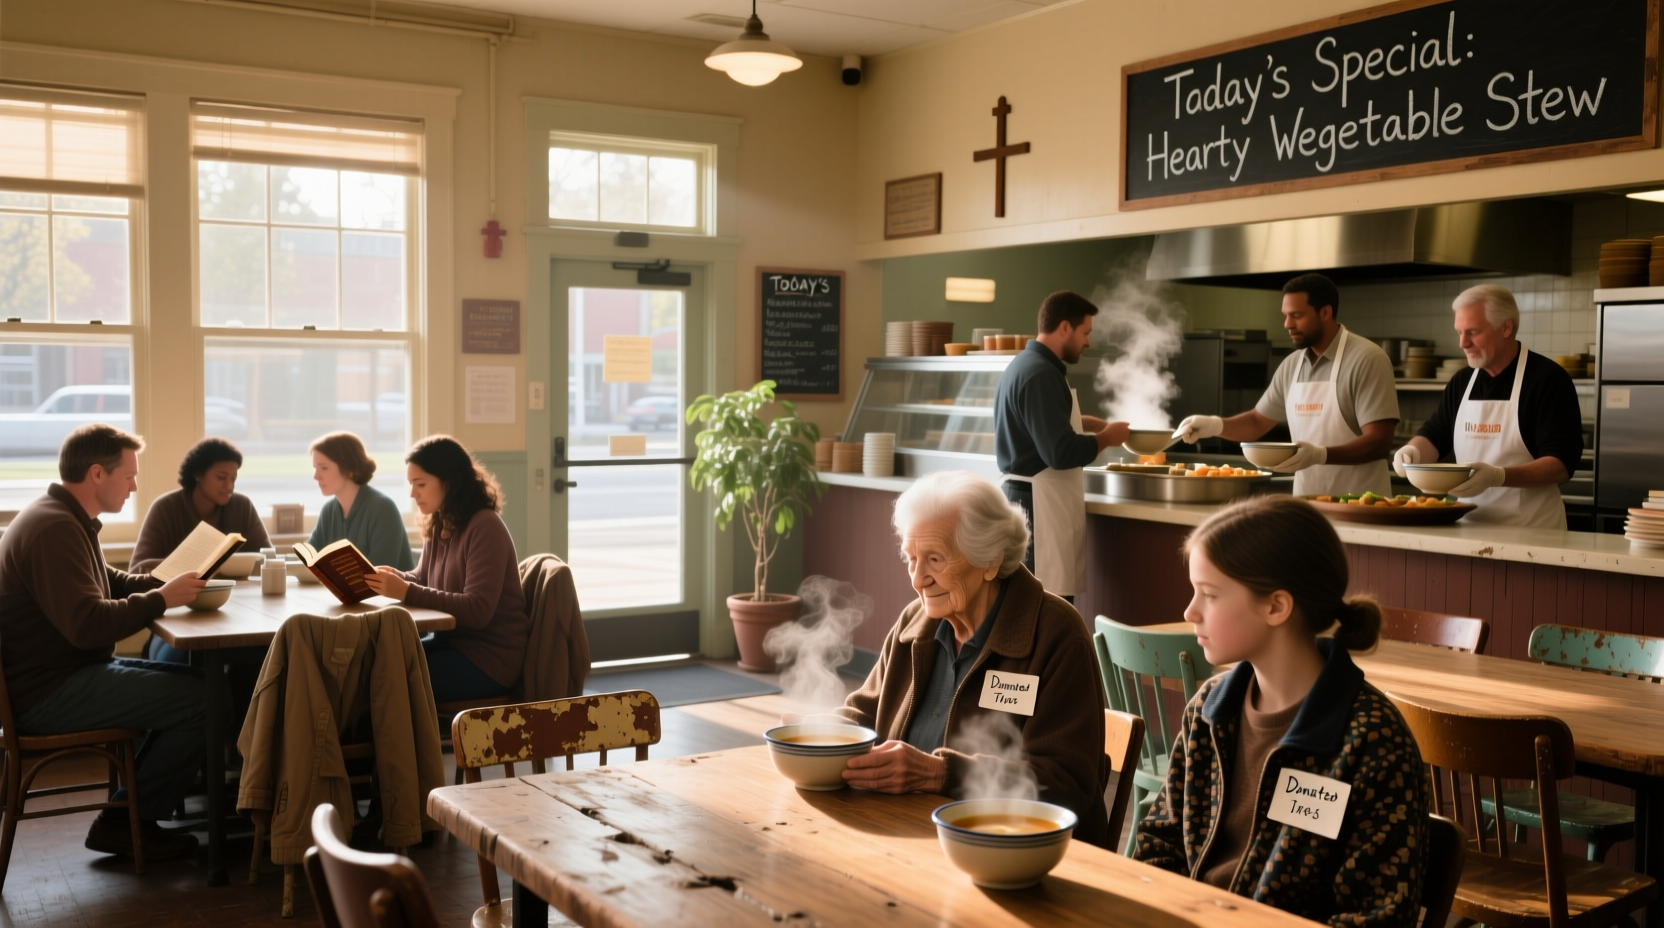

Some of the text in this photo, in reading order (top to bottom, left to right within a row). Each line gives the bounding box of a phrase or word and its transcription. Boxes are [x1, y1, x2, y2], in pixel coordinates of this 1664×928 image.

[1311, 10, 1474, 108] Special:
[1146, 69, 1608, 182] Hearty Wegetable Stew
